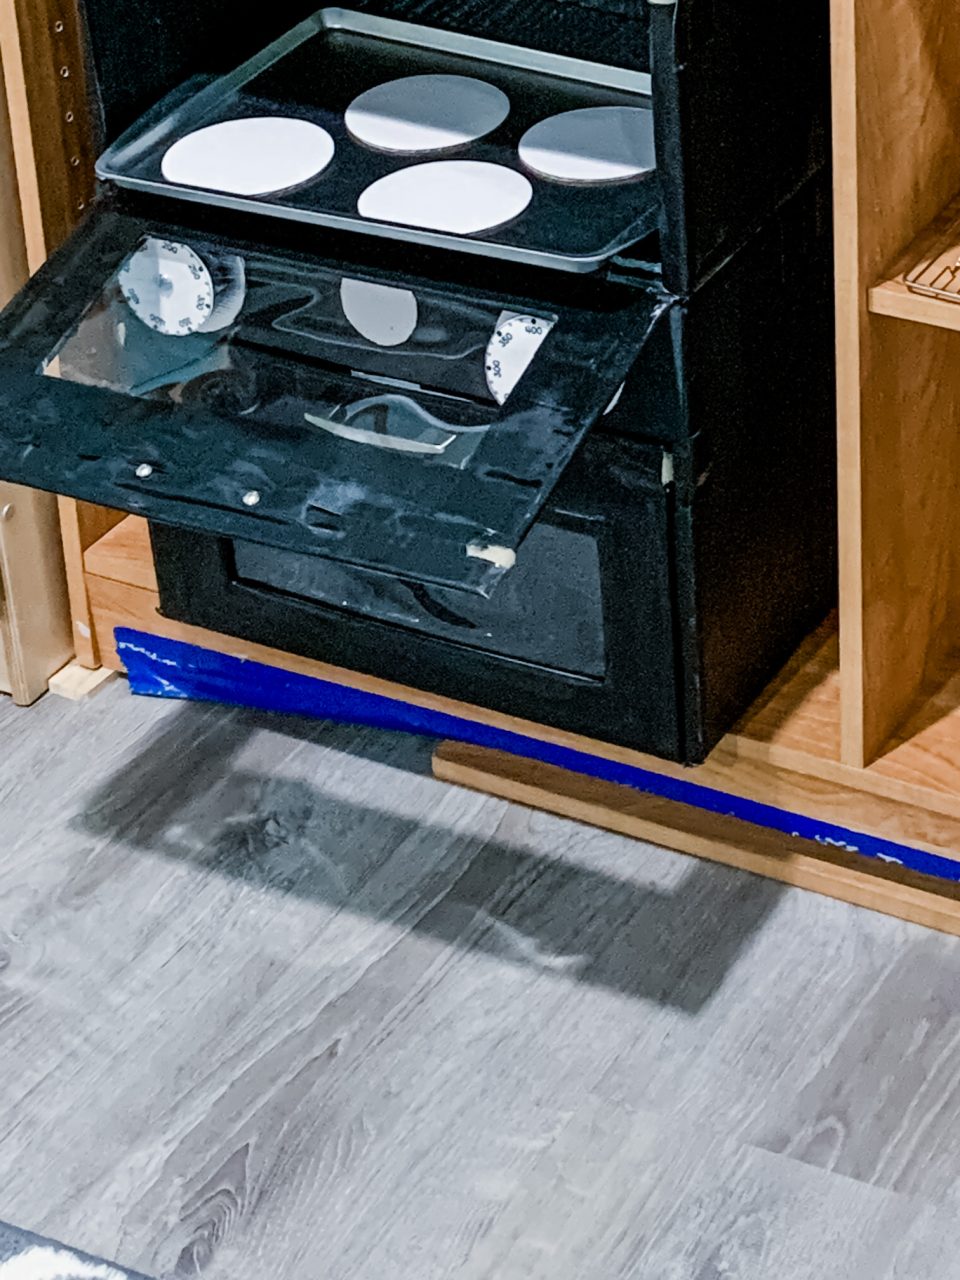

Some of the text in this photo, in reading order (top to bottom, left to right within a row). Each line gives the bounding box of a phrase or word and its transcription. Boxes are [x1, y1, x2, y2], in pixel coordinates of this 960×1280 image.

[525, 325, 543, 335] 400
[498, 332, 513, 348] 350
[492, 360, 502, 378] 300
